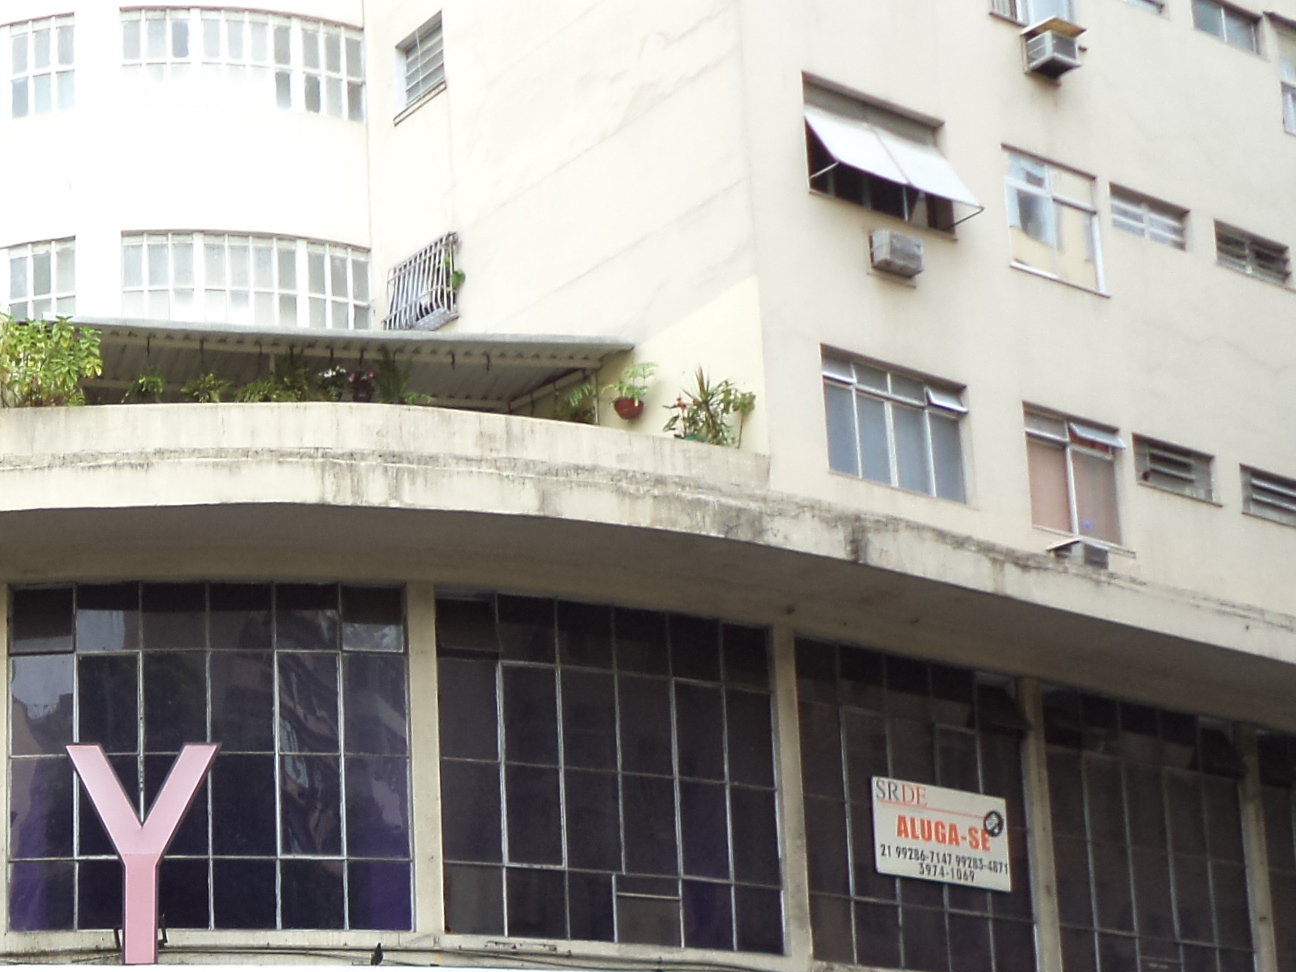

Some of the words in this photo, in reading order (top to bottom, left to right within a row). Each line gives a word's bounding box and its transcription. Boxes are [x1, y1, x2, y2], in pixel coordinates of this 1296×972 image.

[876, 780, 928, 806] SRDE
[896, 814, 991, 852] ALUGA-SE
[880, 844, 892, 858] 21
